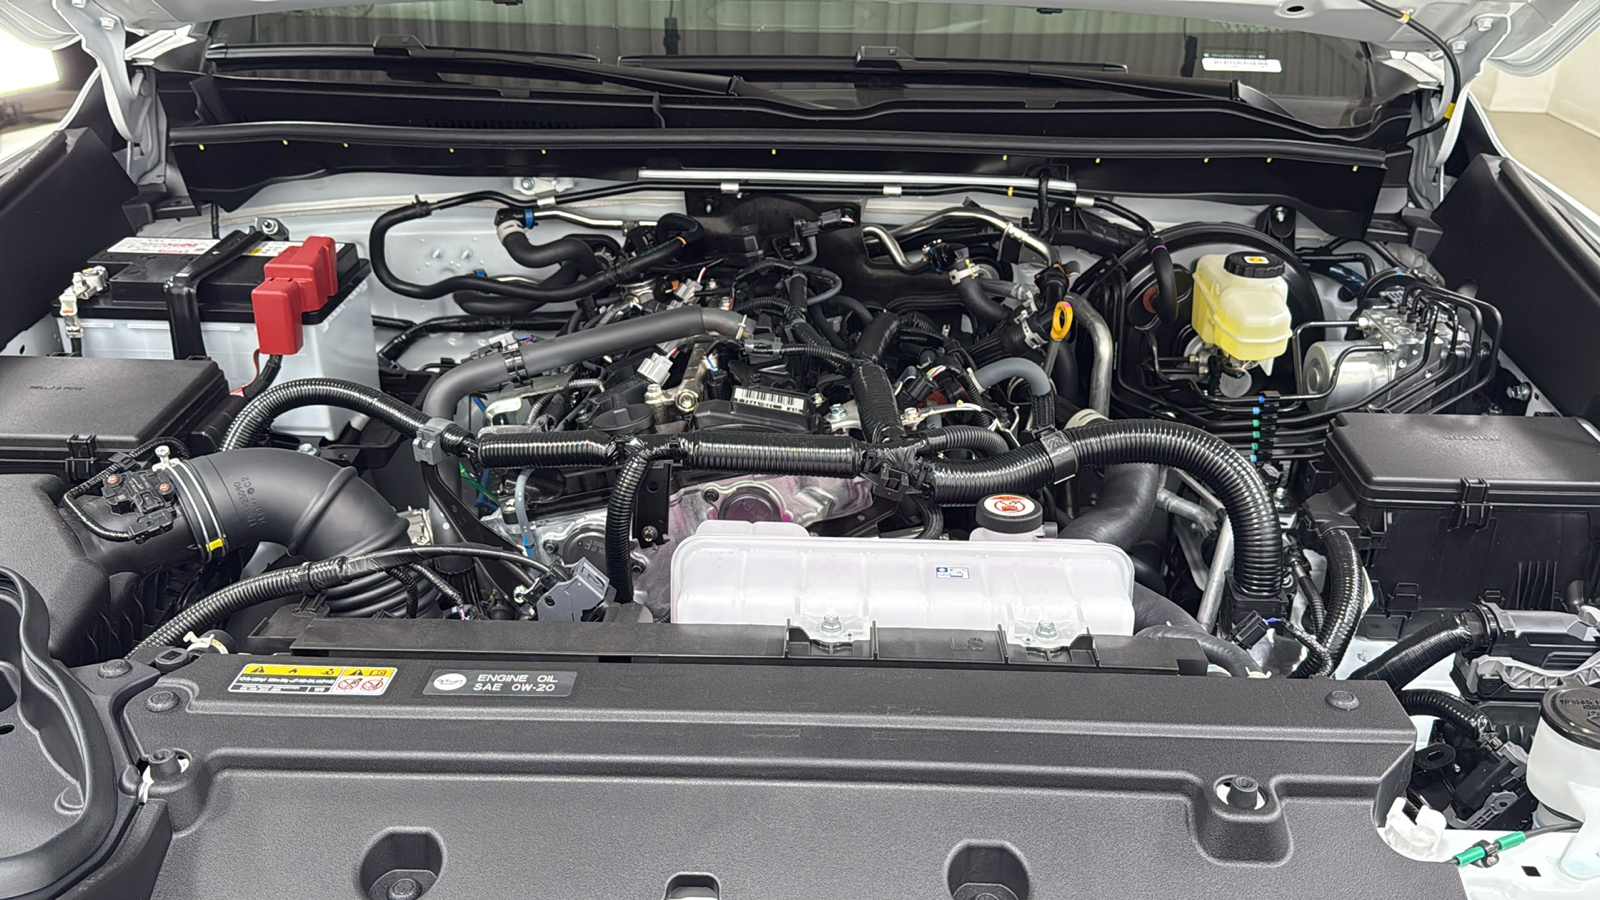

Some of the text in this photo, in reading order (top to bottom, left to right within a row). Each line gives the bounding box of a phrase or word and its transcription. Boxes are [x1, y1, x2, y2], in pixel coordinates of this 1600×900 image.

[476, 674, 558, 682] ENGINE OIL
[473, 683, 556, 691] SAE 0W-20
